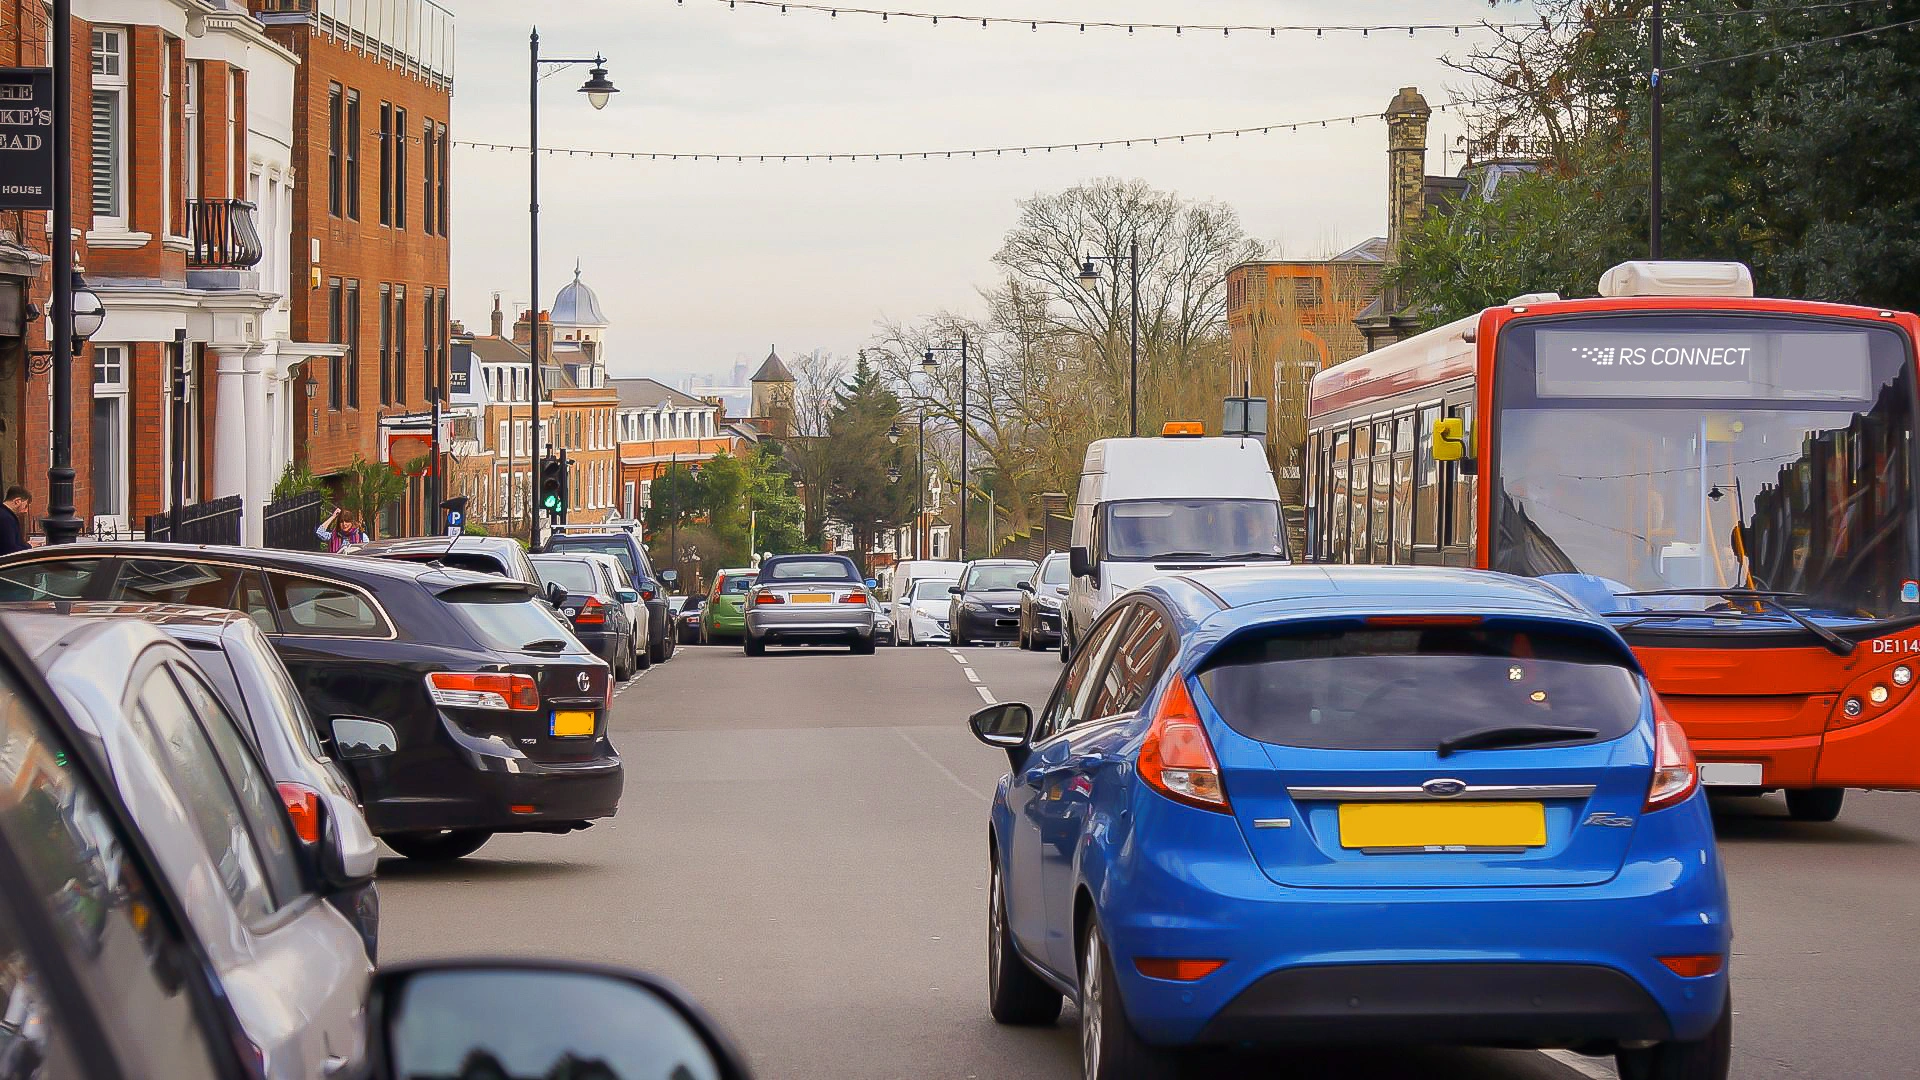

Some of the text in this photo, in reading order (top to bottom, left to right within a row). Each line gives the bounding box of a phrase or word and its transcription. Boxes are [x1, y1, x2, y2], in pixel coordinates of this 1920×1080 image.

[2, 185, 42, 195] HOUSE
[1619, 347, 1751, 365] RS CONNECT
[452, 511, 461, 525] P
[1872, 639, 1920, 653] DE114
